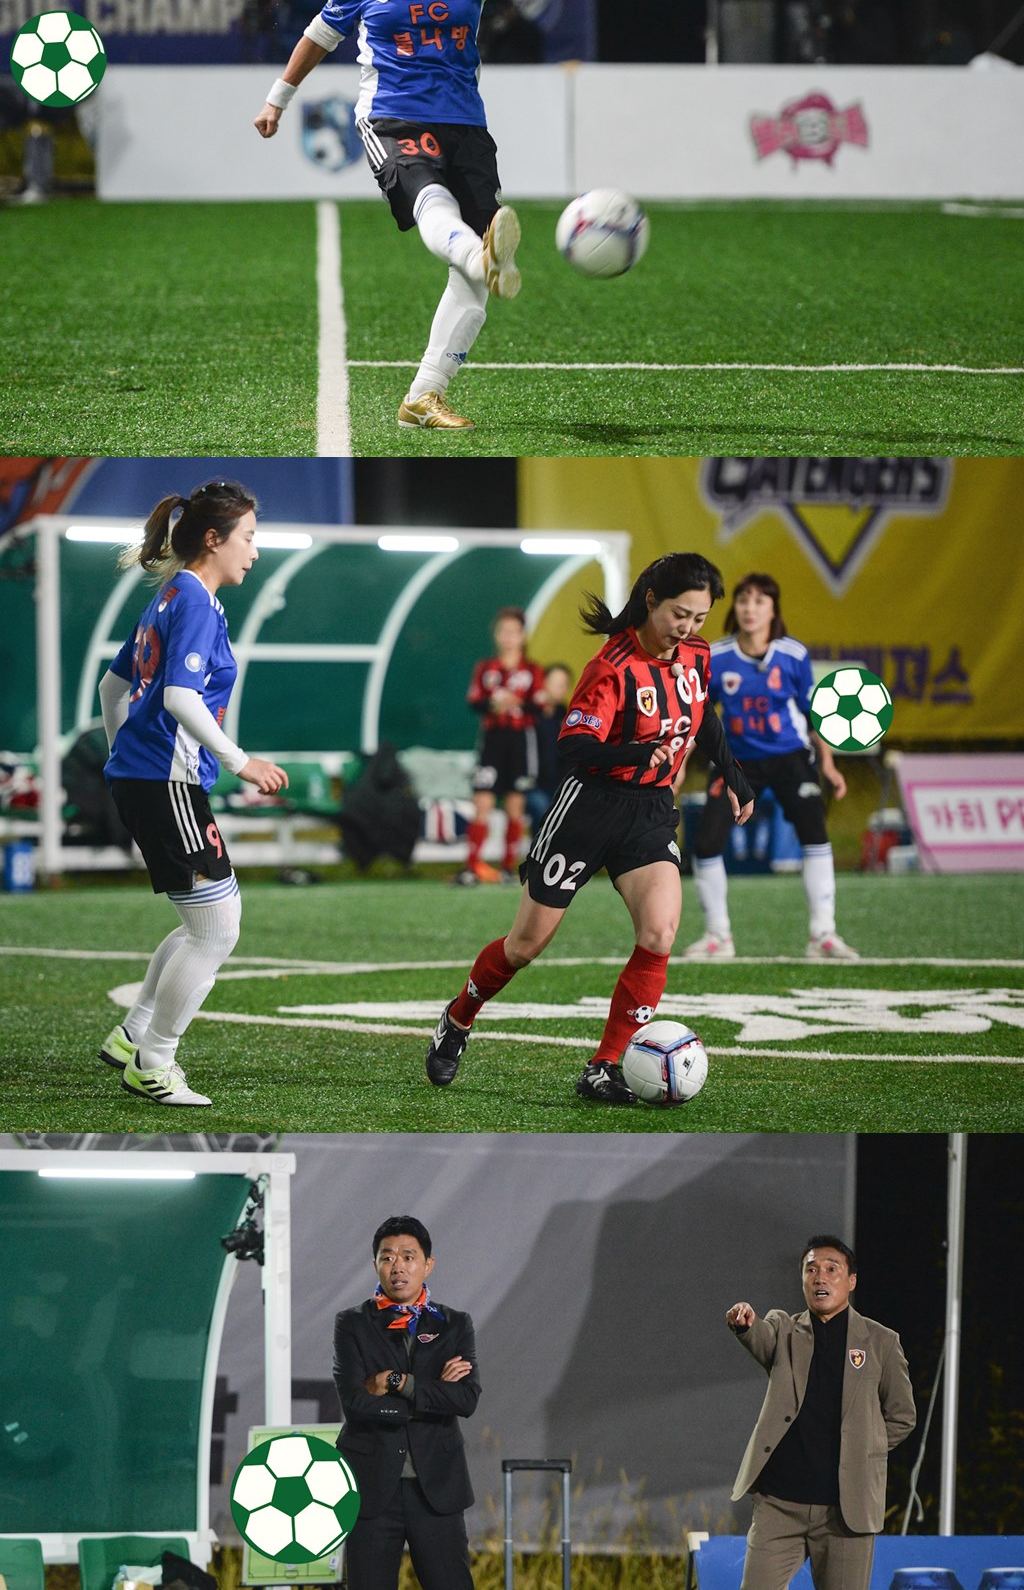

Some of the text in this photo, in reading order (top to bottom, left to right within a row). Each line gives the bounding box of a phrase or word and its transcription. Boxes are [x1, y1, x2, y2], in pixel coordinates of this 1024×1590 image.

[408, 2, 450, 25] FC
[393, 26, 470, 56] 불나방
[398, 132, 441, 156] 30
[676, 667, 707, 705] 02
[659, 715, 692, 737] FC
[542, 852, 587, 891] 02
